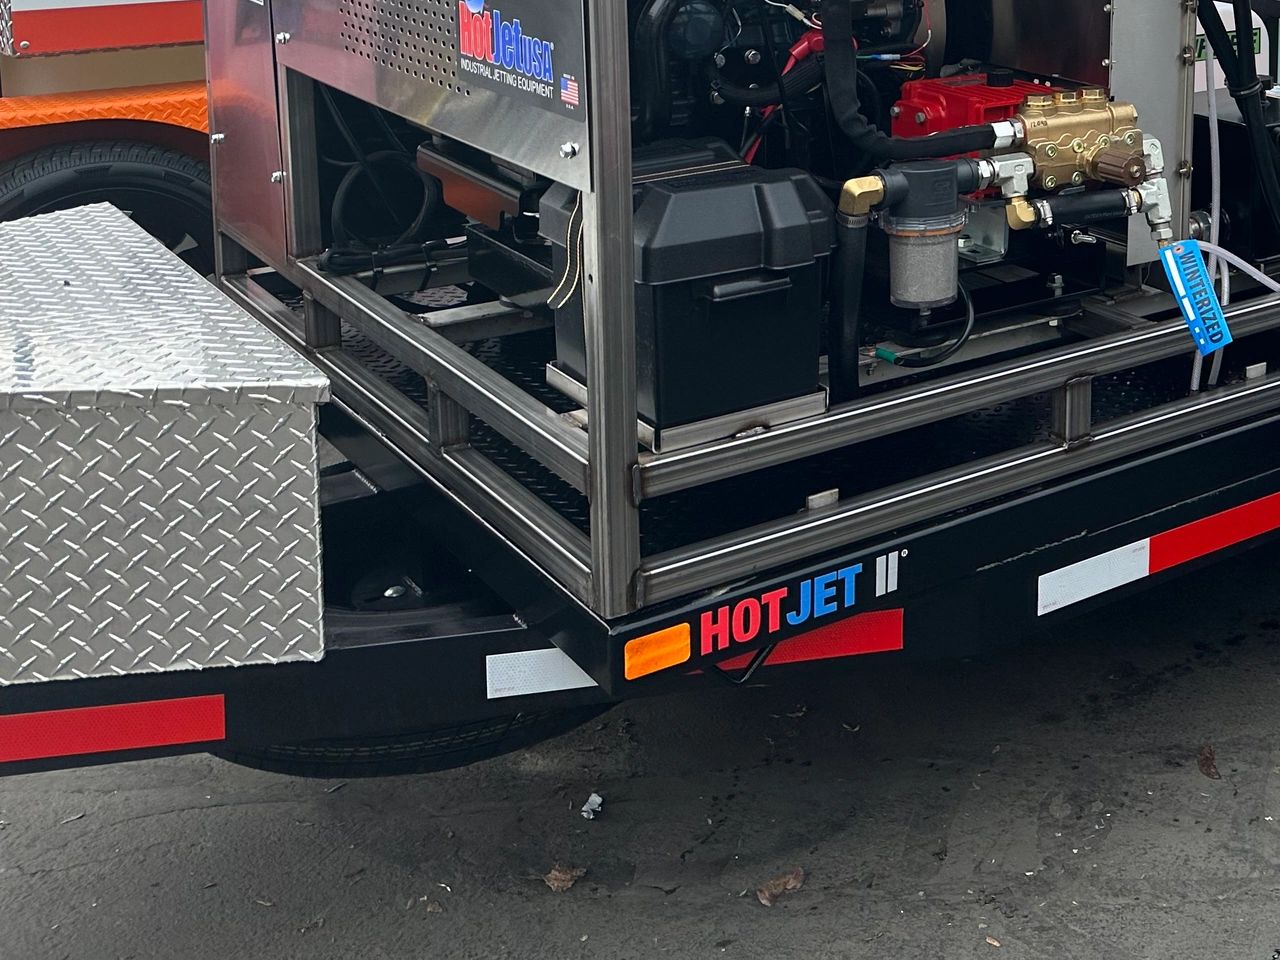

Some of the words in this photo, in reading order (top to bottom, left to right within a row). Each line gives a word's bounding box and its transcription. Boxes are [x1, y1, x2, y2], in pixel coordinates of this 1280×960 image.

[460, 58, 493, 79] INDUSTRIAL
[492, 67, 517, 88] JETTING
[517, 76, 554, 99] EQUIPMENT
[1179, 250, 1224, 344] WINTERIZED
[700, 562, 863, 656] HOTJET
